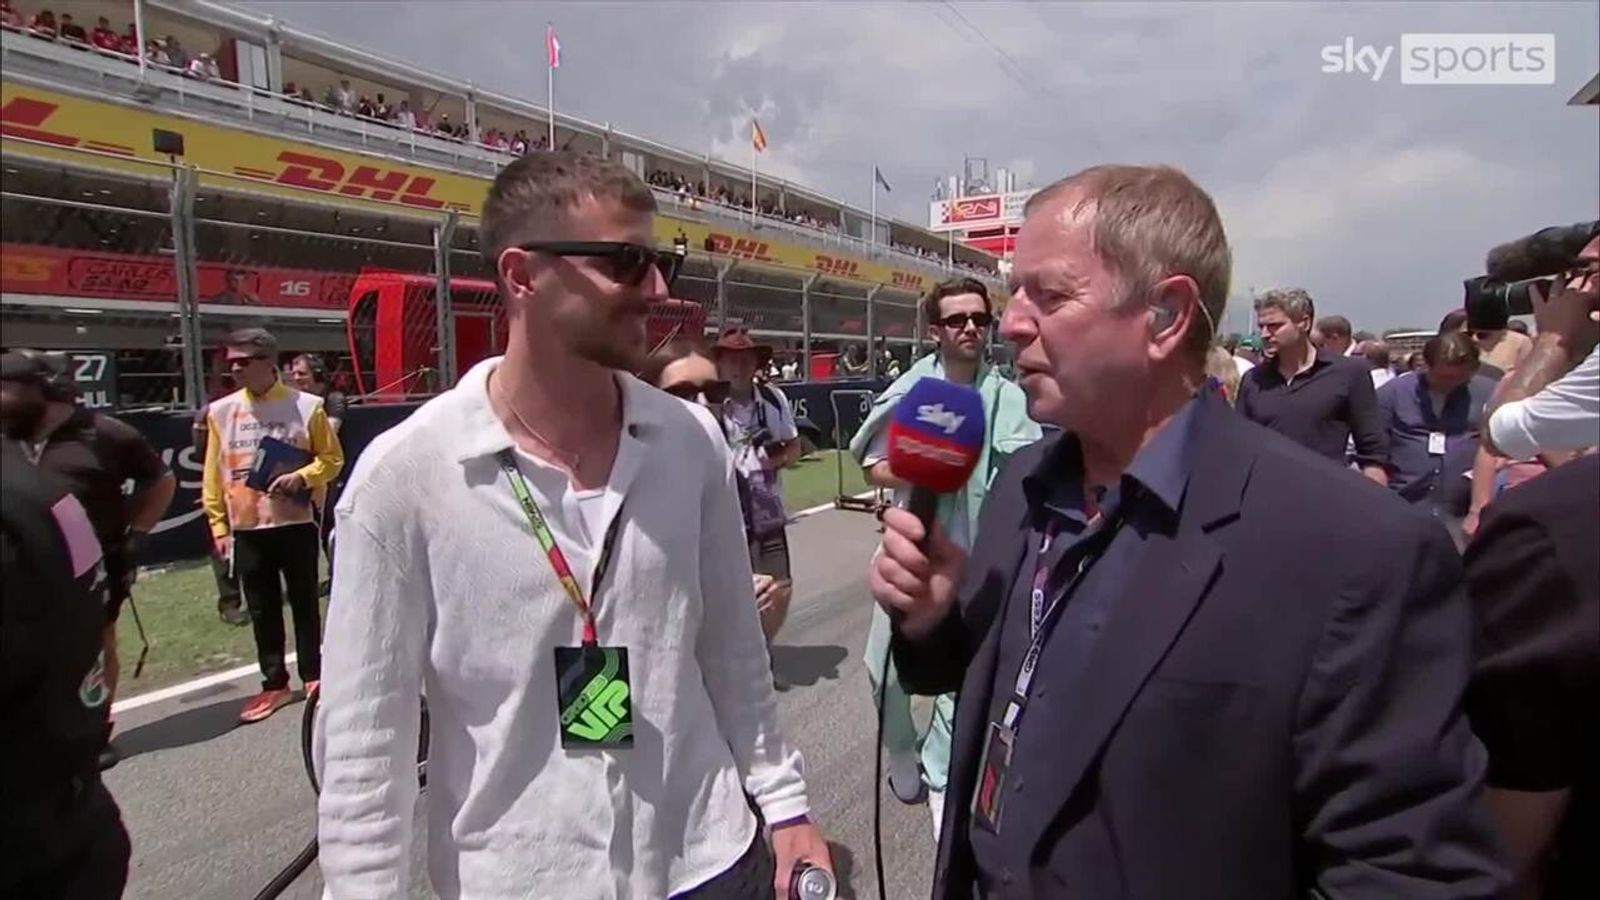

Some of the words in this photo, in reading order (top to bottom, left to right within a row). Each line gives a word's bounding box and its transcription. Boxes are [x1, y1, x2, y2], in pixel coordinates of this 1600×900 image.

[275, 151, 446, 208] DHL
[708, 233, 772, 261] DHL
[816, 255, 860, 276] DHL
[280, 280, 311, 297] 16
[891, 271, 923, 289] DHL
[73, 355, 107, 381] 27
[915, 403, 967, 433] sky
[566, 679, 629, 741] VIP
